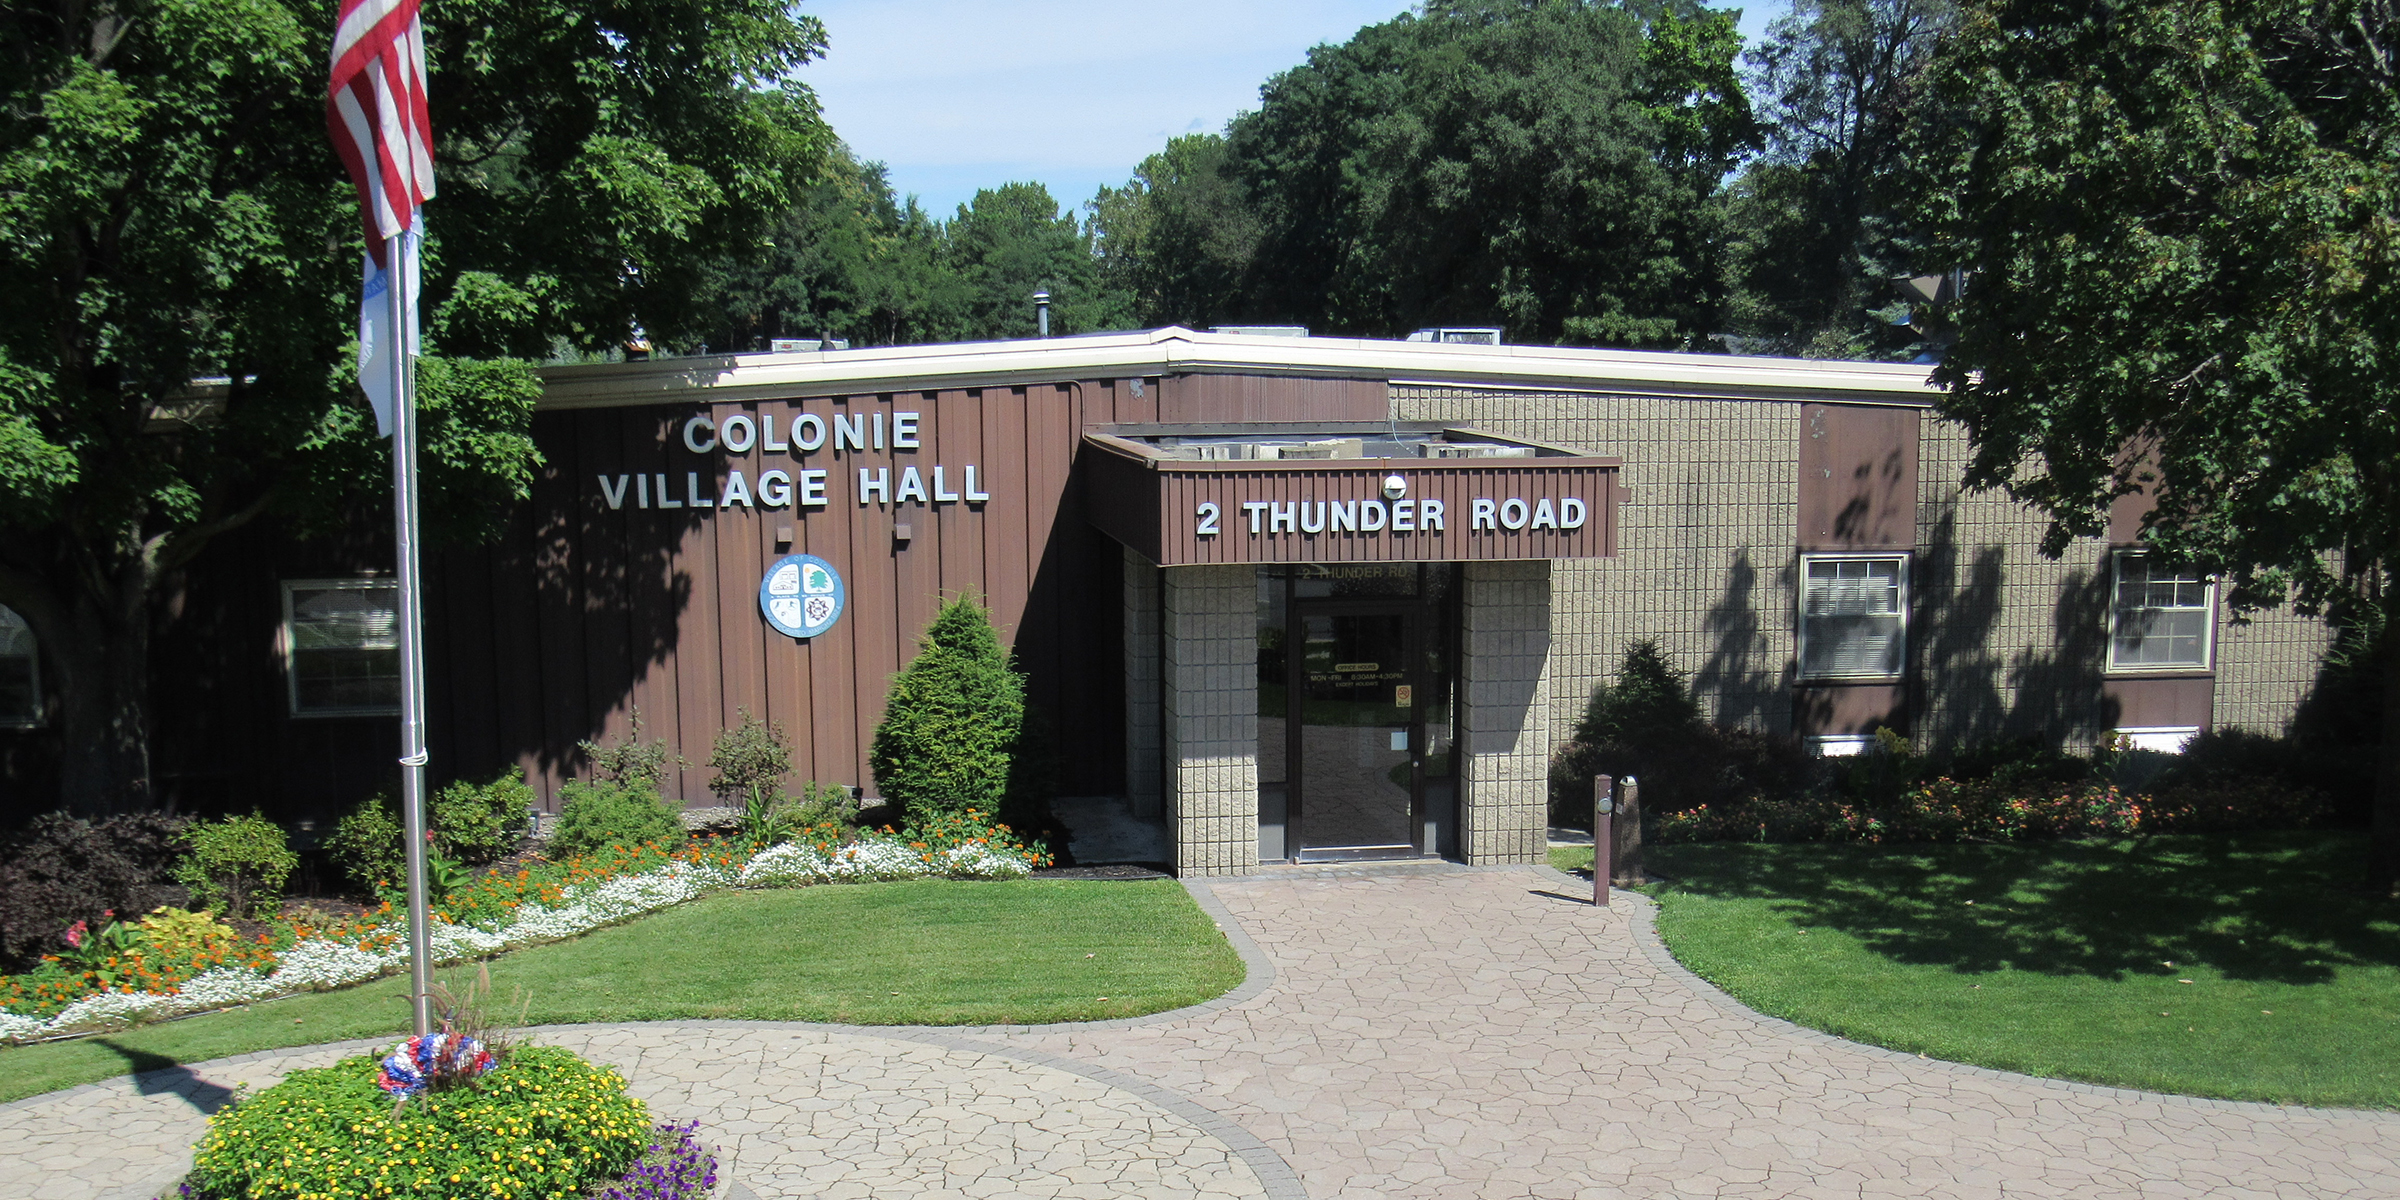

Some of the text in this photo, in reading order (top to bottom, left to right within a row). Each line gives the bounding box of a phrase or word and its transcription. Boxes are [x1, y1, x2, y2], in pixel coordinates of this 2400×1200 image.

[683, 411, 921, 454] COLONIE
[598, 465, 990, 511] VILLAGE HALL
[1197, 497, 1587, 535] 2 THUNDER ROAD
[764, 558, 789, 583] VILLAGE
[808, 556, 839, 581] COLONIE
[1302, 566, 1408, 580] 2 THUNDER RD
